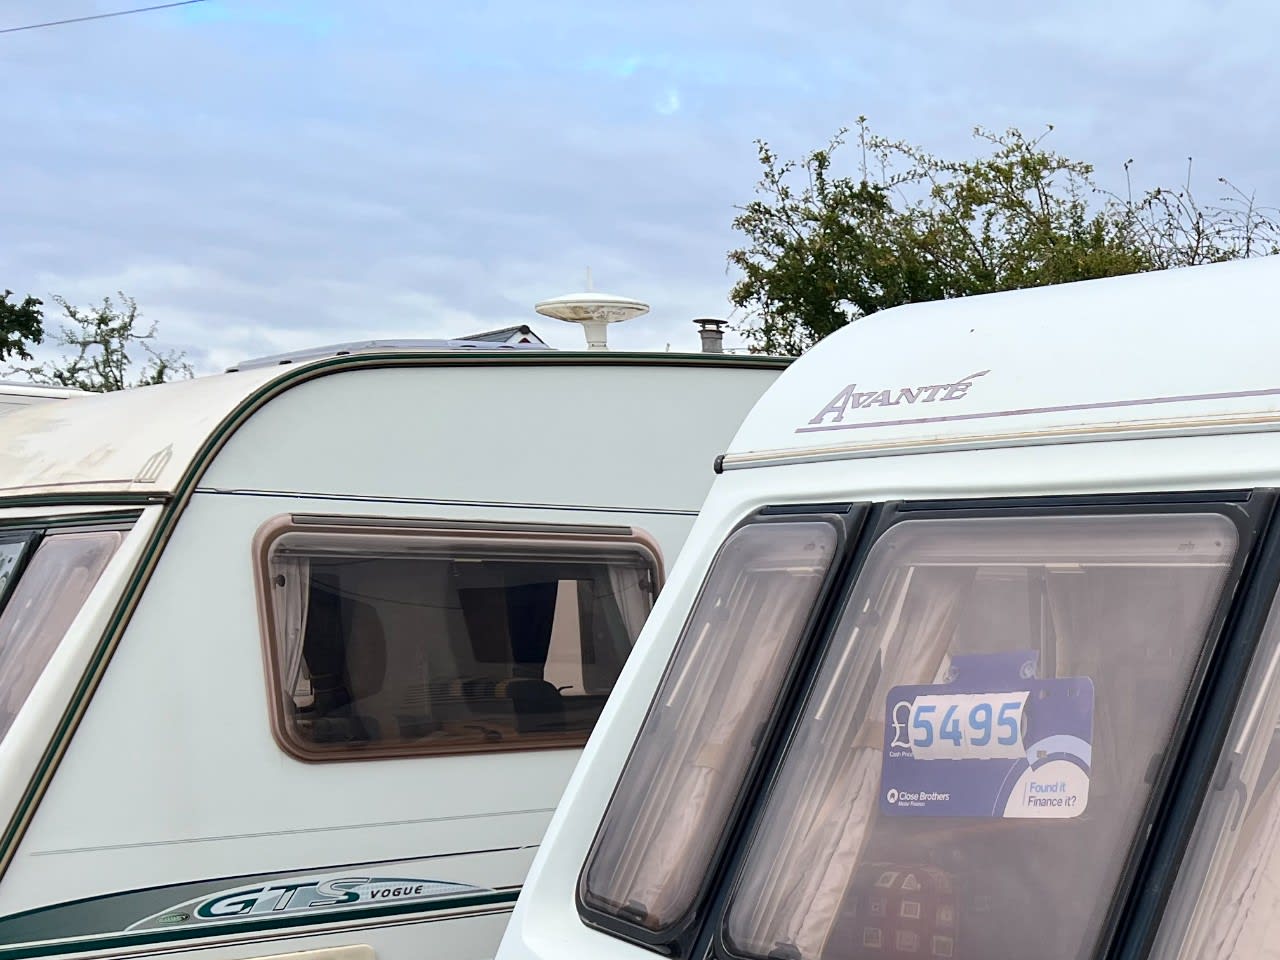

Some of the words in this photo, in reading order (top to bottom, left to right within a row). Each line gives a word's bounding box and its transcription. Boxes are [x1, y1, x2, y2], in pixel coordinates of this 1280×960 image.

[1030, 781, 1058, 793] Found
[1059, 782, 1067, 792] it
[899, 791, 919, 801] Close
[920, 791, 950, 801] Brothers
[1028, 795, 1063, 807] Finance
[1064, 795, 1077, 807] it?
[197, 877, 370, 918] GTS
[370, 885, 423, 899] VOGUE
